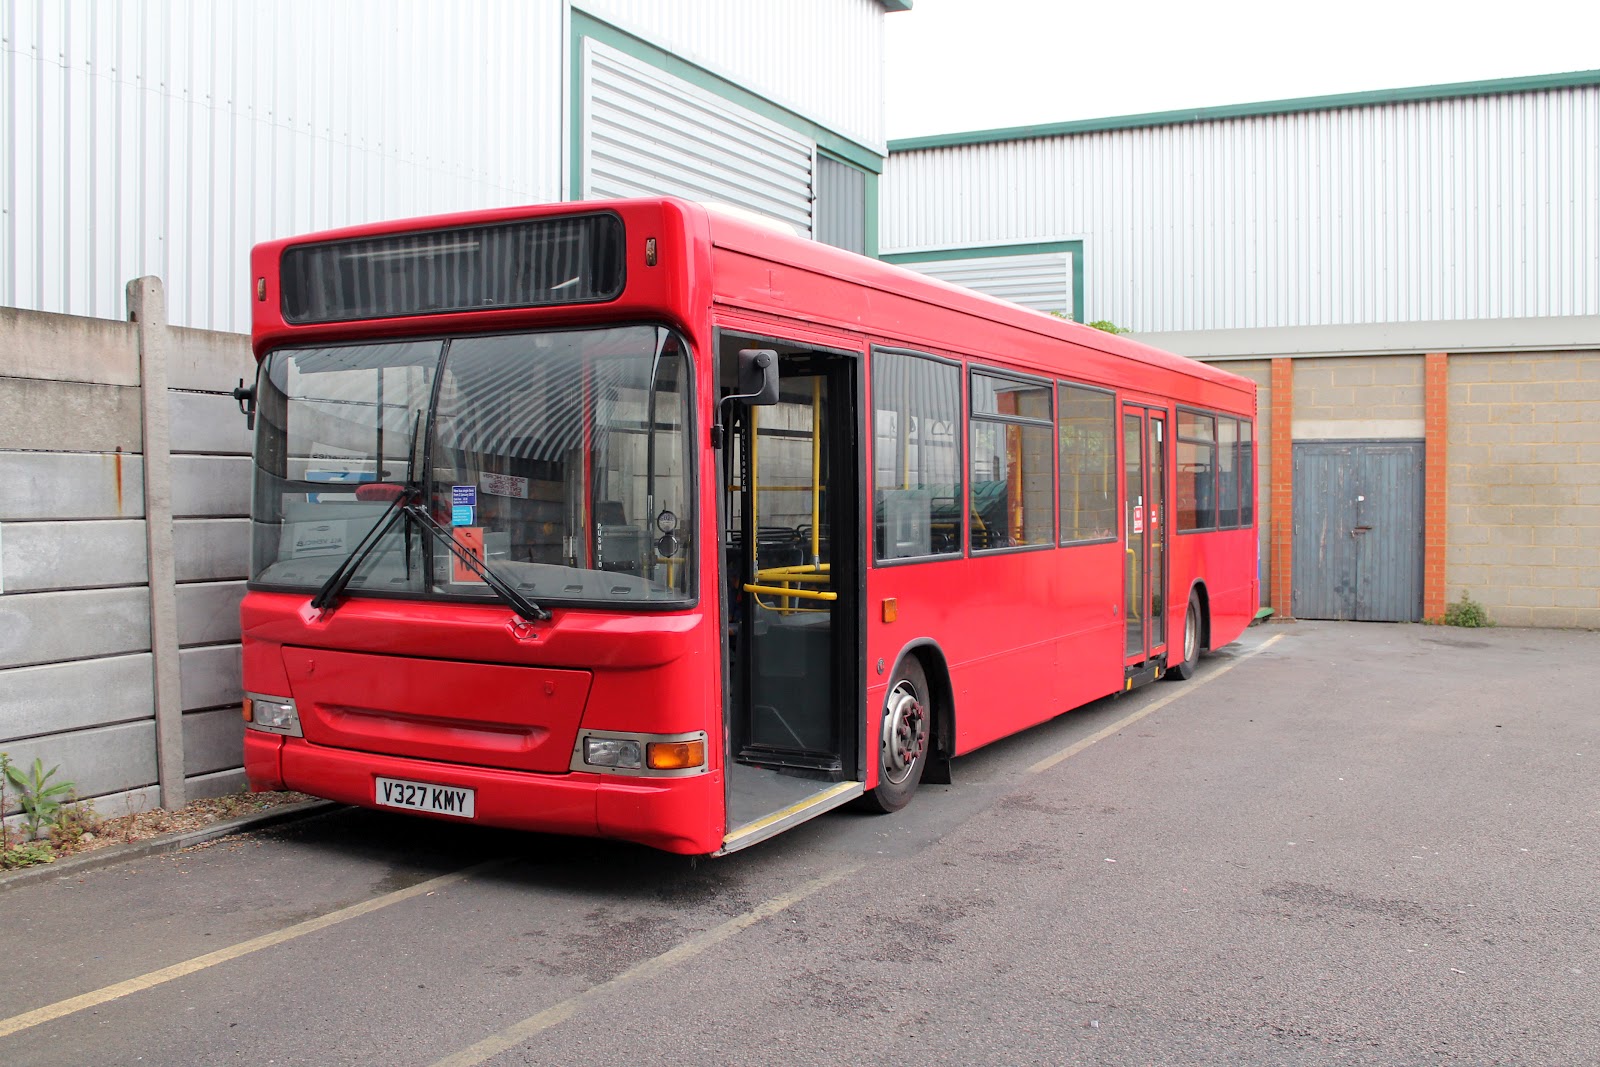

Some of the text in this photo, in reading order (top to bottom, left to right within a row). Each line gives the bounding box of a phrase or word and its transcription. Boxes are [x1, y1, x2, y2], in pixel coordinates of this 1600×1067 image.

[597, 554, 603, 568] TO
[383, 782, 467, 813] V327 KMY
